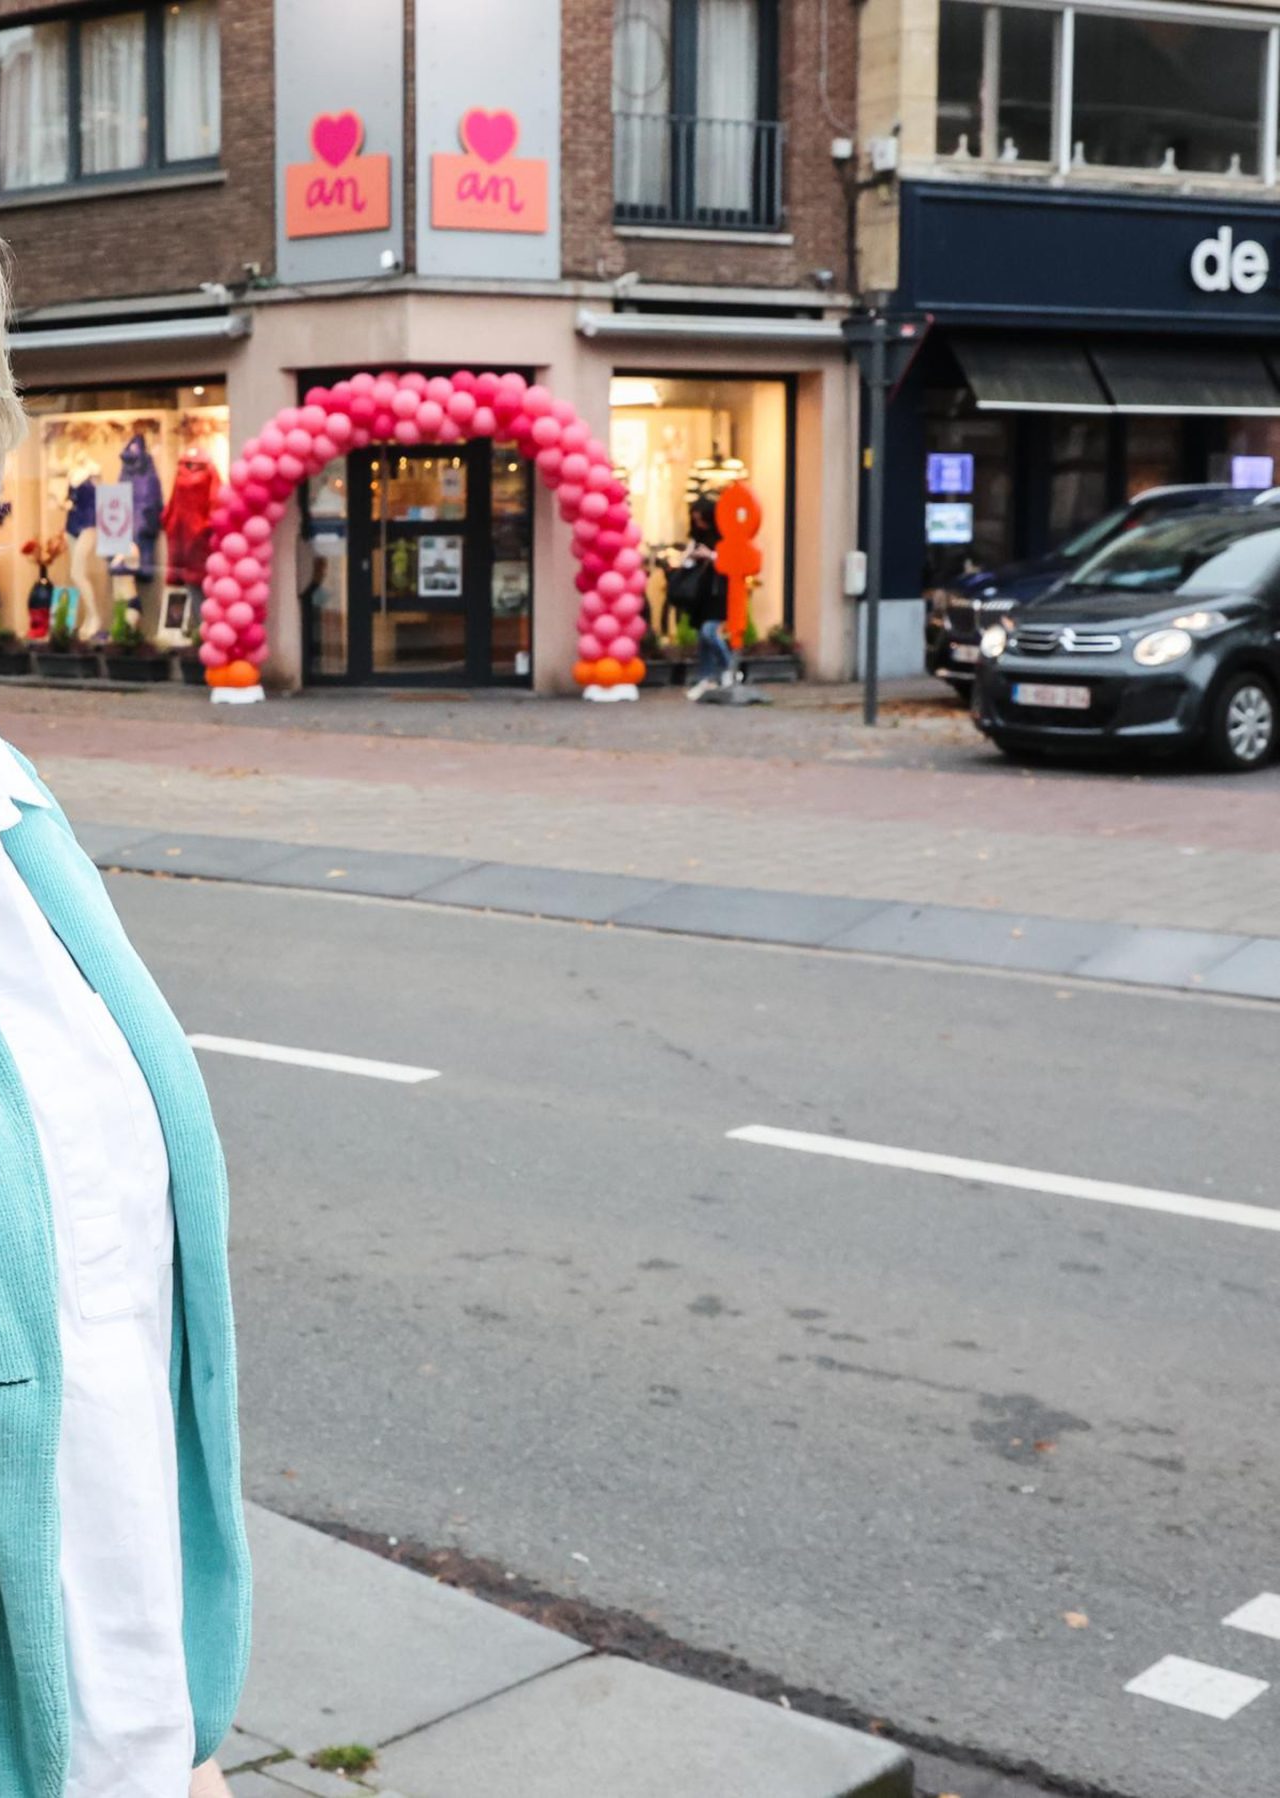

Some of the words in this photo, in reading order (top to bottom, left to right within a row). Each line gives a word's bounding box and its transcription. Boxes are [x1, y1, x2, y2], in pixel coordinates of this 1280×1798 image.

[305, 177, 366, 213] an
[456, 171, 524, 213] an
[1190, 225, 1269, 293] de
